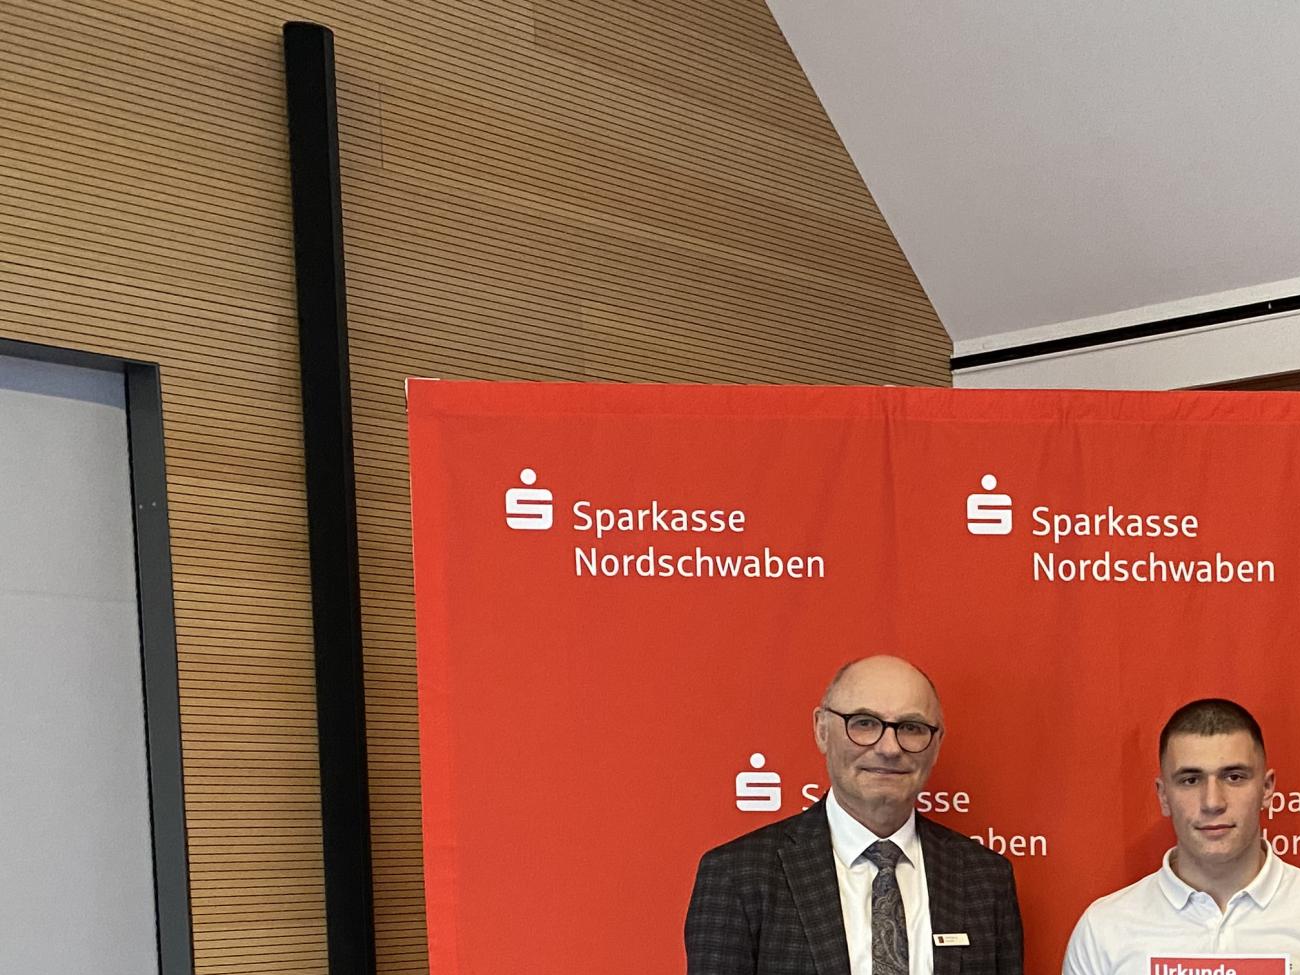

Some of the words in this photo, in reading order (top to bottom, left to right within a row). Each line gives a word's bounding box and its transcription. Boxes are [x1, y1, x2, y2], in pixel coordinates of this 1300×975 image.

[572, 500, 746, 539] Sparkasse
[1032, 505, 1199, 544] Sparkasse
[575, 546, 825, 579] Nordschwaben
[1033, 551, 1275, 583] Nordschwaben
